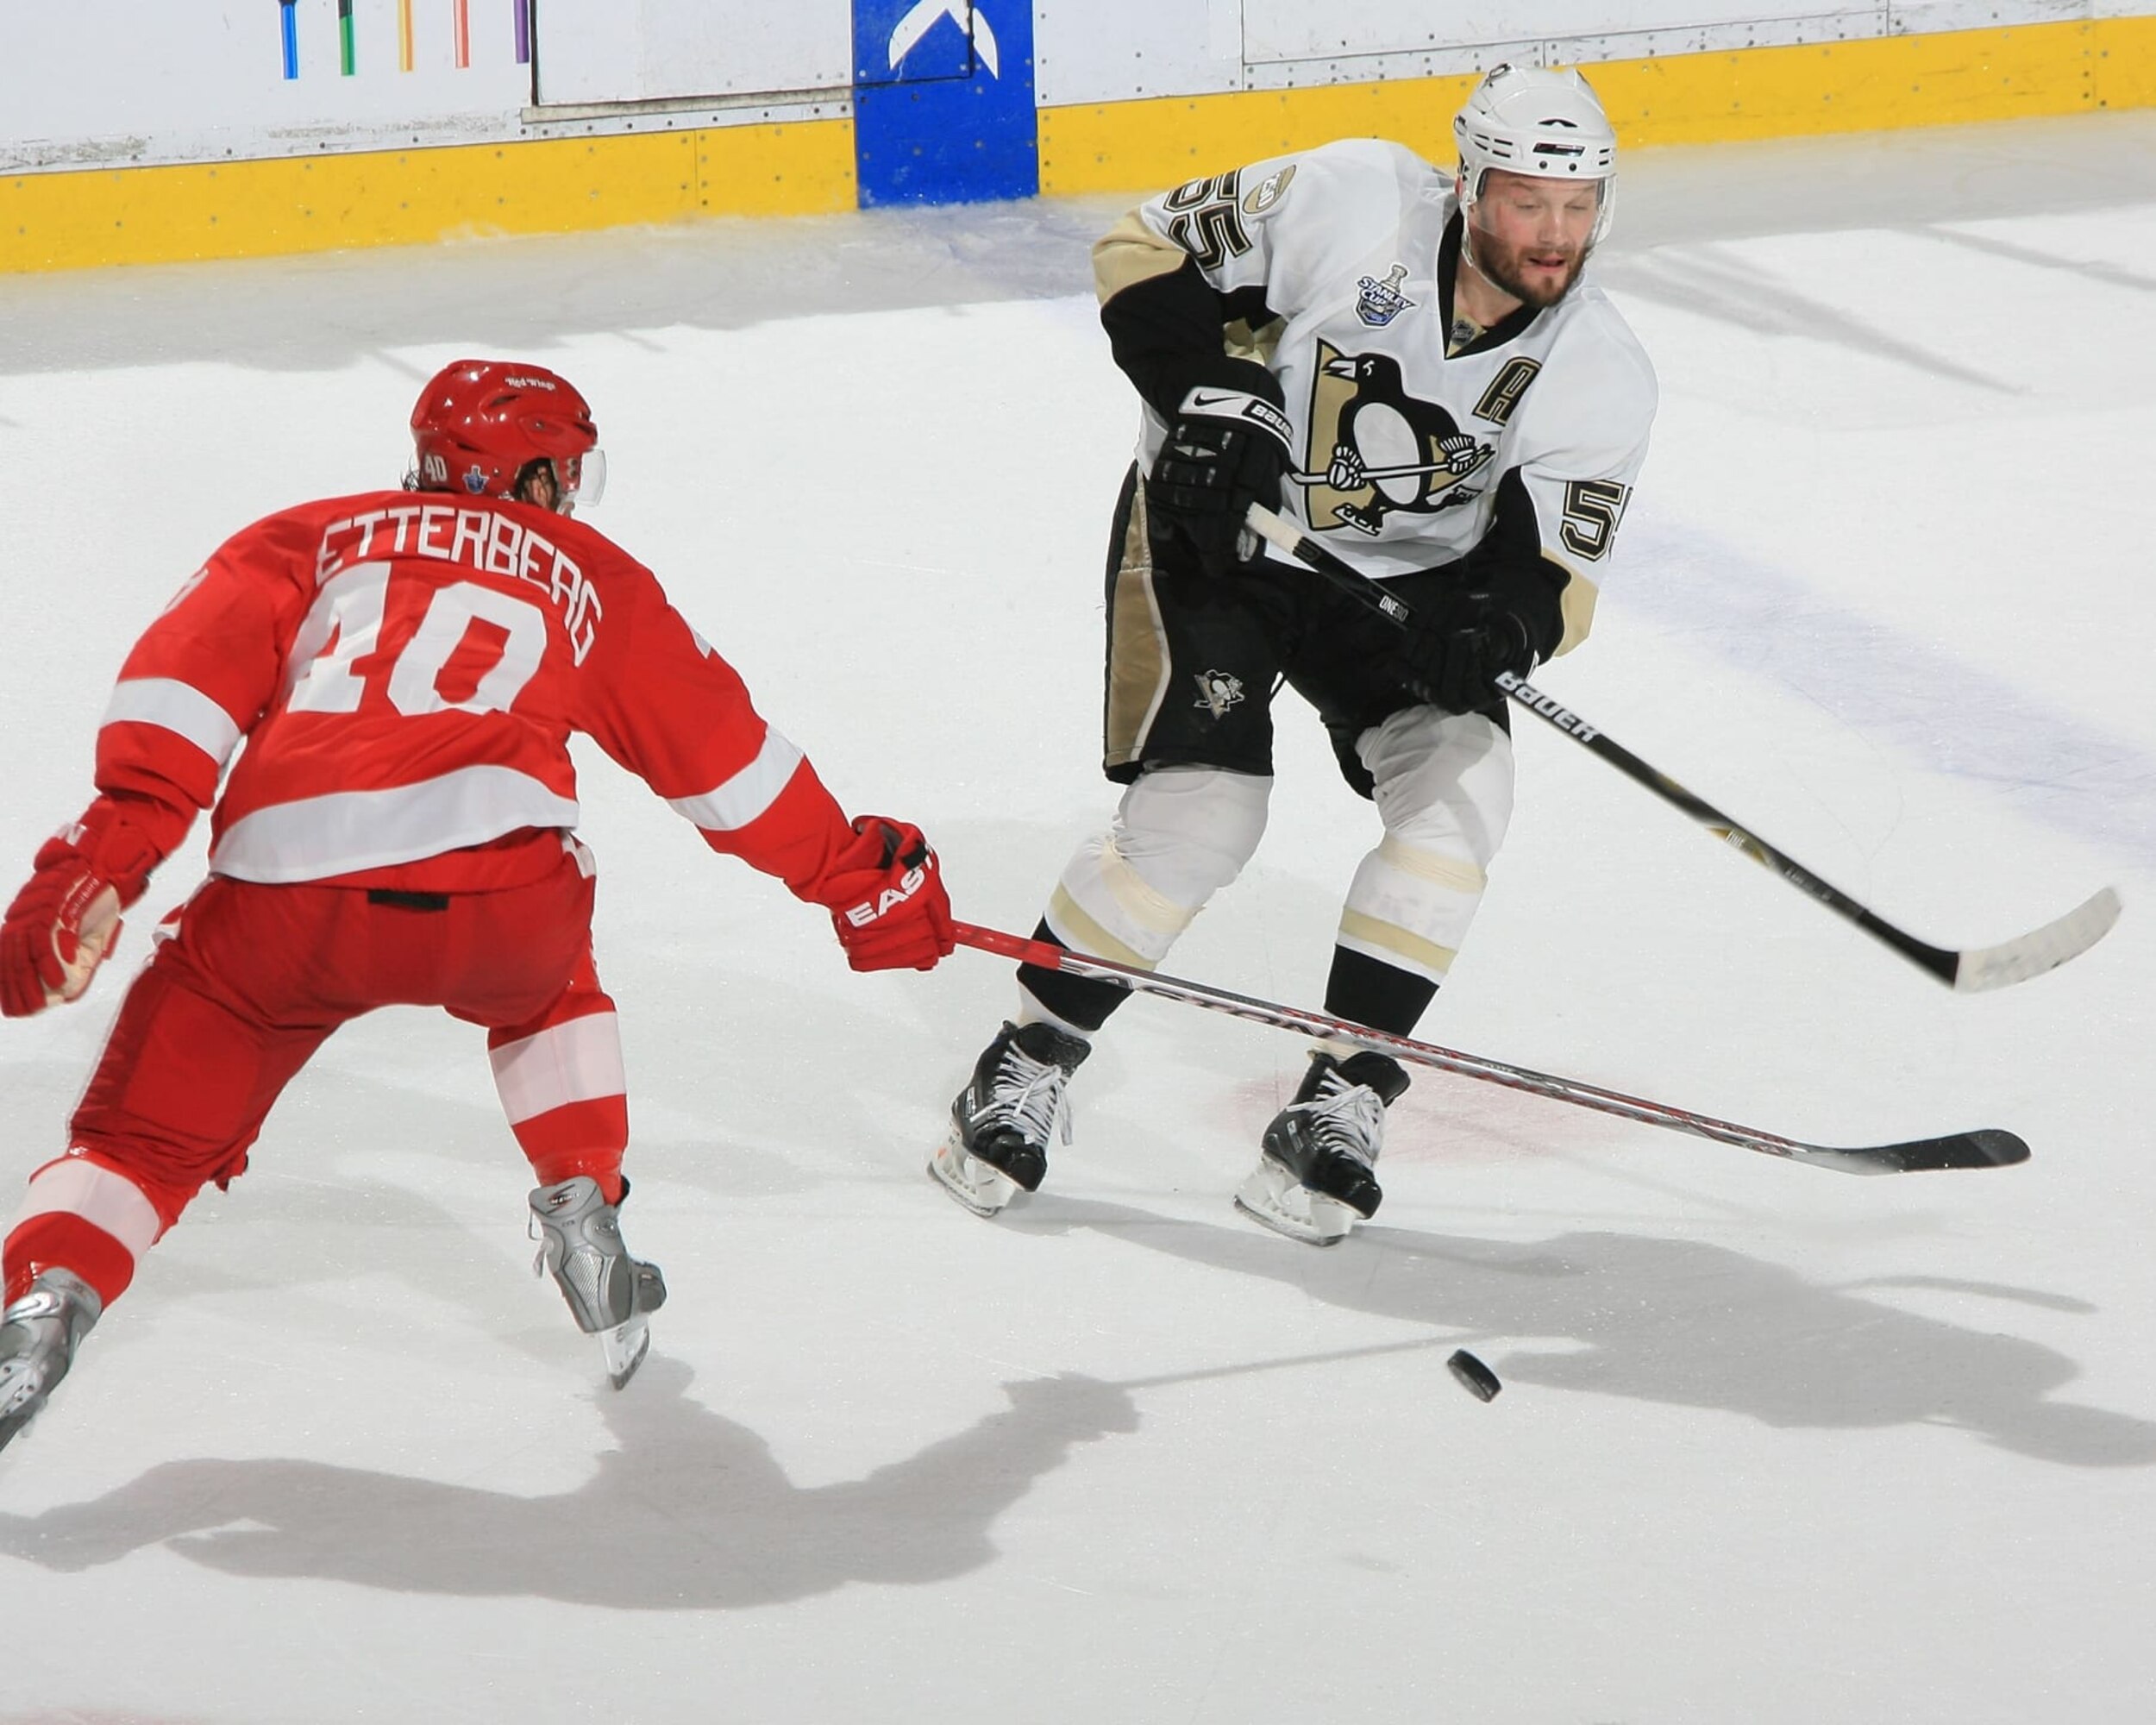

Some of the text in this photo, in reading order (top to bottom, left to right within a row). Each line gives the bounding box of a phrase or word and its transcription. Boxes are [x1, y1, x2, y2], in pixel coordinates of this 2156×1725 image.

[1358, 277, 1412, 310] STANLEY
[1361, 289, 1387, 305] CUP
[1471, 356, 1542, 427] A
[424, 453, 448, 482] 40
[1559, 479, 1633, 562] 5
[316, 505, 602, 668] ETTERBERG
[284, 561, 547, 717] 40
[845, 844, 932, 928] EAS
